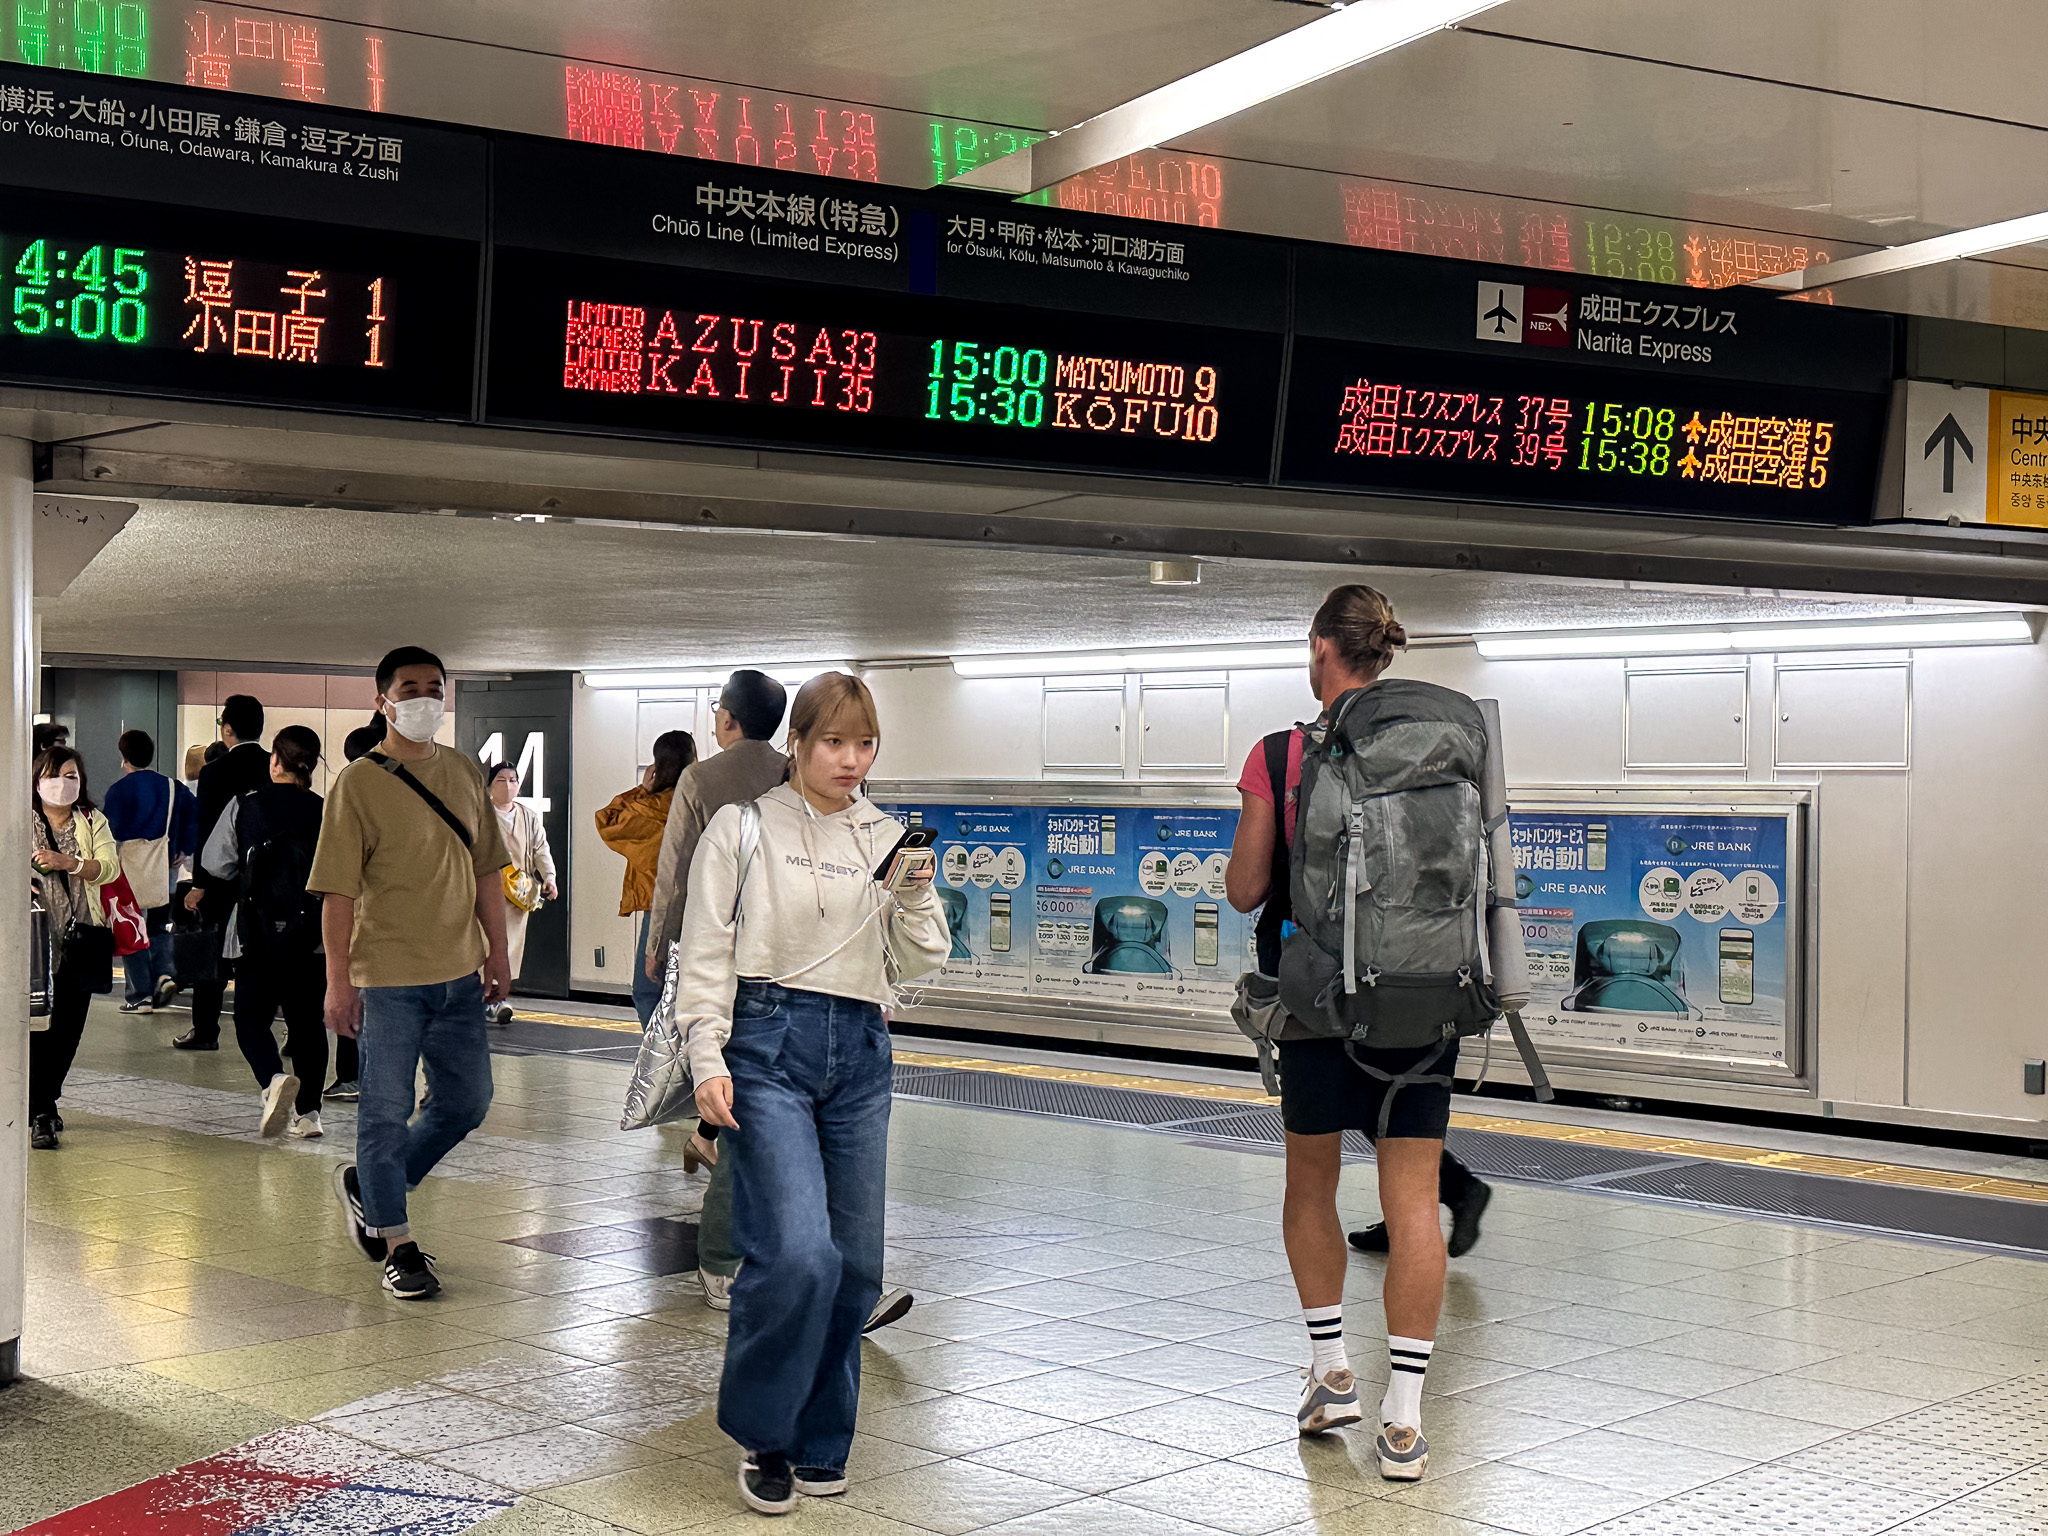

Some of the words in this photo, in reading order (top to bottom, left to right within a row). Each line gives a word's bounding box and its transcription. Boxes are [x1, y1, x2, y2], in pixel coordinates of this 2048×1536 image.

[0, 116, 19, 133] or
[25, 119, 115, 147] Yokohama,
[121, 129, 174, 154] Ōfuna,
[179, 139, 255, 165] Odawara,
[260, 150, 338, 174] Kamakura
[342, 161, 354, 176] &
[358, 163, 399, 182] Zushi
[696, 181, 900, 238] 中央本線(特急)
[652, 214, 701, 237] Chūō
[706, 221, 745, 243] Line
[750, 224, 819, 252] (Limited
[825, 236, 899, 263] Express)
[947, 214, 1186, 265] 大月・甲府・松本・河口湖方面
[946, 240, 963, 254] for
[1042, 253, 1104, 273] Matsumoto
[1106, 261, 1116, 273] &
[1118, 261, 1191, 282] Kawaguchiko
[184, 255, 326, 315] 逗子
[367, 277, 386, 321] 1
[183, 300, 326, 364] 小田原
[365, 323, 385, 367] 1
[567, 299, 646, 329] LIMITED
[1529, 320, 1553, 332] NEX
[1579, 293, 1738, 335] 成田エクスプレス
[565, 323, 645, 351] EXPRESS
[1577, 328, 1633, 356] Narita
[1639, 334, 1713, 364] Express
[564, 344, 643, 373] LIMITED
[928, 338, 1049, 389] 15:00
[1055, 354, 1186, 400] MATSUMOTO
[1193, 366, 1218, 404] 9
[563, 366, 642, 395] EXPRESS
[925, 379, 1045, 428] 15:30
[1338, 377, 1503, 426] 成田エクスプレス
[1582, 402, 1676, 442] 15:08
[1704, 411, 1812, 460] 成田空港
[1813, 421, 1835, 456] 5
[1334, 415, 1500, 462] 成田エクスプレス
[1577, 436, 1672, 477] 15:38
[1700, 444, 1806, 490] 成田空港
[1808, 456, 1829, 490] 5
[1512, 844, 1584, 871] 新始動!
[1691, 841, 1714, 851] JRE
[1717, 842, 1752, 852] BANK
[1067, 865, 1086, 875] JRE
[1088, 865, 1116, 876] BANK
[1540, 882, 1565, 894] JRE
[1568, 883, 1607, 895] BANK
